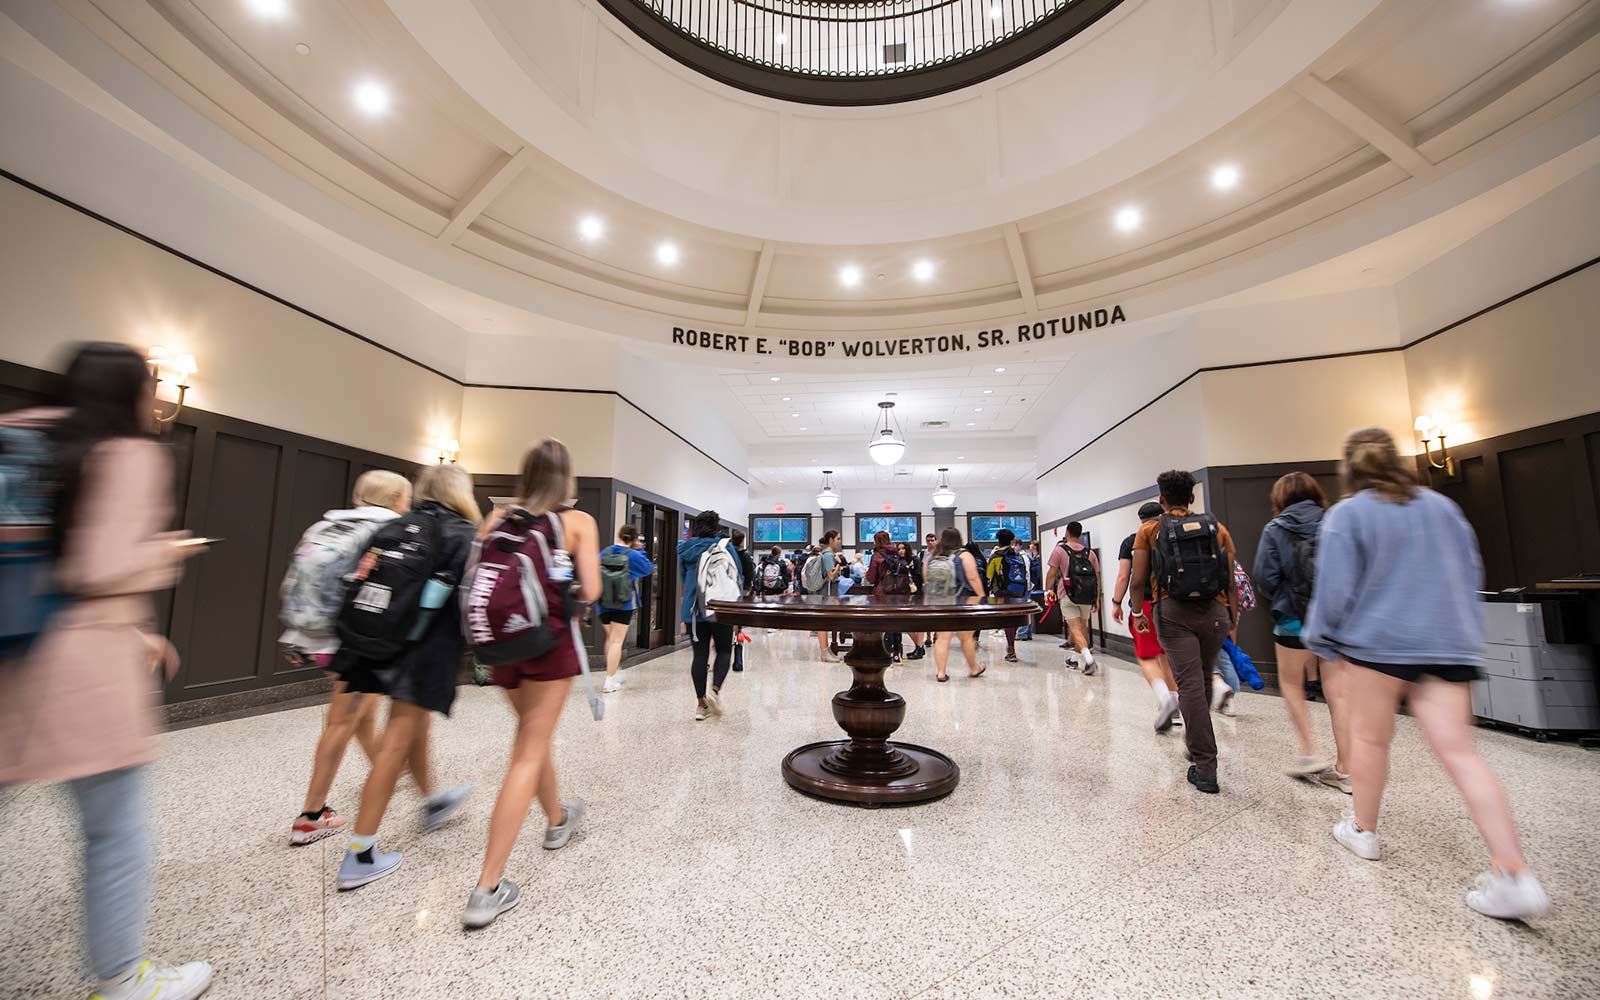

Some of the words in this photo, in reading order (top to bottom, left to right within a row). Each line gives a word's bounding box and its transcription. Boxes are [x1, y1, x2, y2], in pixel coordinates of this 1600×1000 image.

[673, 327, 749, 352] ROBERT
[757, 338, 772, 354] E.
[842, 334, 970, 356] WOLVERTON,
[978, 329, 1009, 347] SR.
[1018, 305, 1126, 342] ROTUNDA
